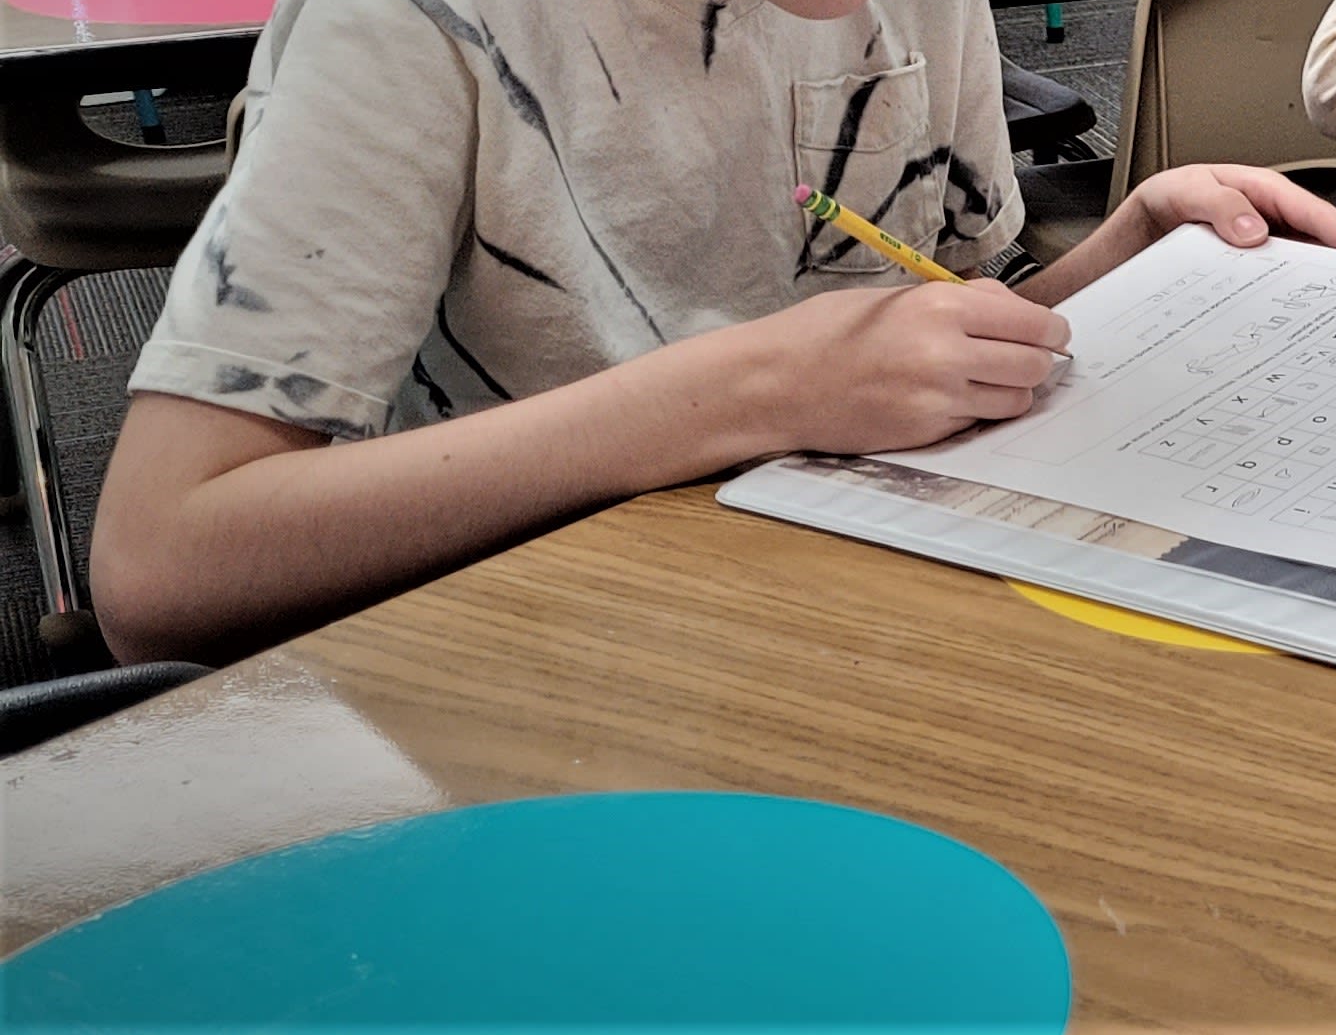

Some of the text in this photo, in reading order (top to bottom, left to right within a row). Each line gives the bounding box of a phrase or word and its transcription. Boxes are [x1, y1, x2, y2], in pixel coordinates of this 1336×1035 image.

[1265, 373, 1286, 384] w
[1231, 395, 1249, 404] x
[1196, 417, 1214, 426] y
[1312, 415, 1327, 424] o
[1277, 436, 1293, 446] p
[1236, 460, 1257, 469] q
[1206, 485, 1219, 493] r
